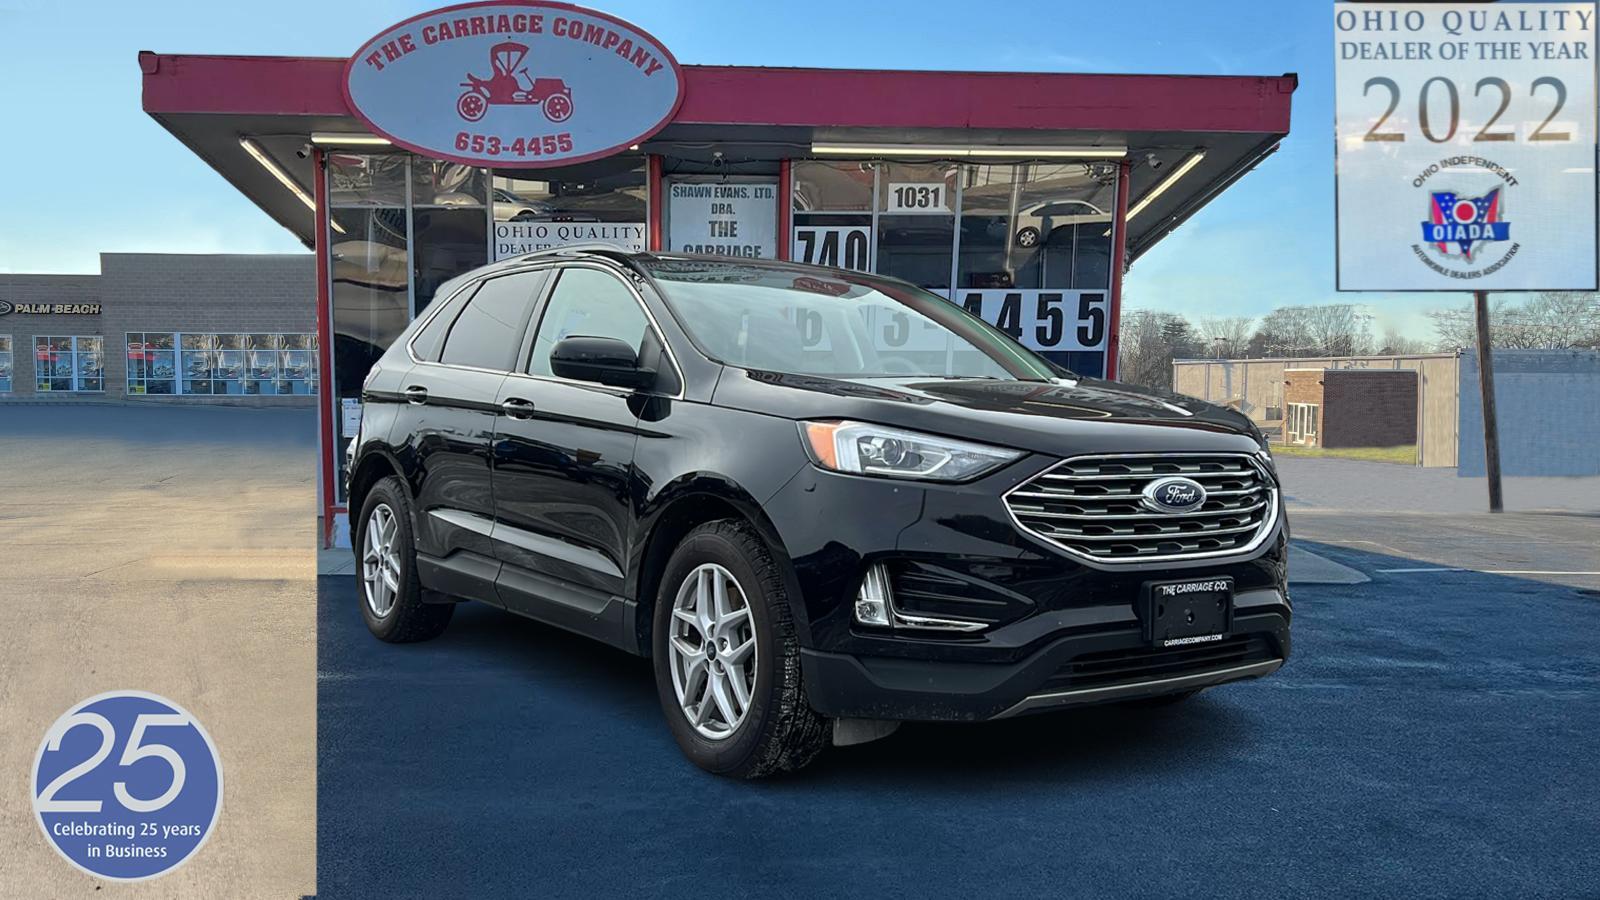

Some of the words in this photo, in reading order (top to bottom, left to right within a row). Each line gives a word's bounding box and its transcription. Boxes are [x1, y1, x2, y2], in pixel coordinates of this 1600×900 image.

[1336, 9, 1426, 32] OHIO
[1442, 9, 1593, 36] QUALITY
[366, 33, 417, 71] THE
[422, 14, 544, 46] CARRIAGE
[552, 17, 664, 77] COMPANY
[1340, 41, 1433, 60] DEALER
[1438, 41, 1470, 60] OF
[1475, 41, 1521, 60] THE
[1528, 41, 1589, 60] YEAR
[1362, 75, 1571, 143] 2022
[454, 131, 573, 157] 653-4455
[1412, 163, 1440, 188] OHIO
[1440, 155, 1519, 188] INDEPENDENT
[672, 186, 712, 198] SHAWN
[894, 186, 940, 208] 1031
[711, 203, 736, 215] DBA.
[497, 226, 548, 239] OHIO
[557, 226, 643, 241] QUALITY
[708, 220, 738, 238] THE
[1432, 224, 1495, 241] OIADA
[798, 230, 868, 272] 740
[1411, 243, 1449, 277] AUTOMOBILE
[1449, 269, 1483, 280] DEALERS
[1482, 242, 1520, 277] ASSOCIATION
[15, 303, 51, 314] PALM
[1165, 484, 1196, 504] Ford
[1162, 585, 1176, 595] THE
[1176, 581, 1214, 594] CARRIAGE
